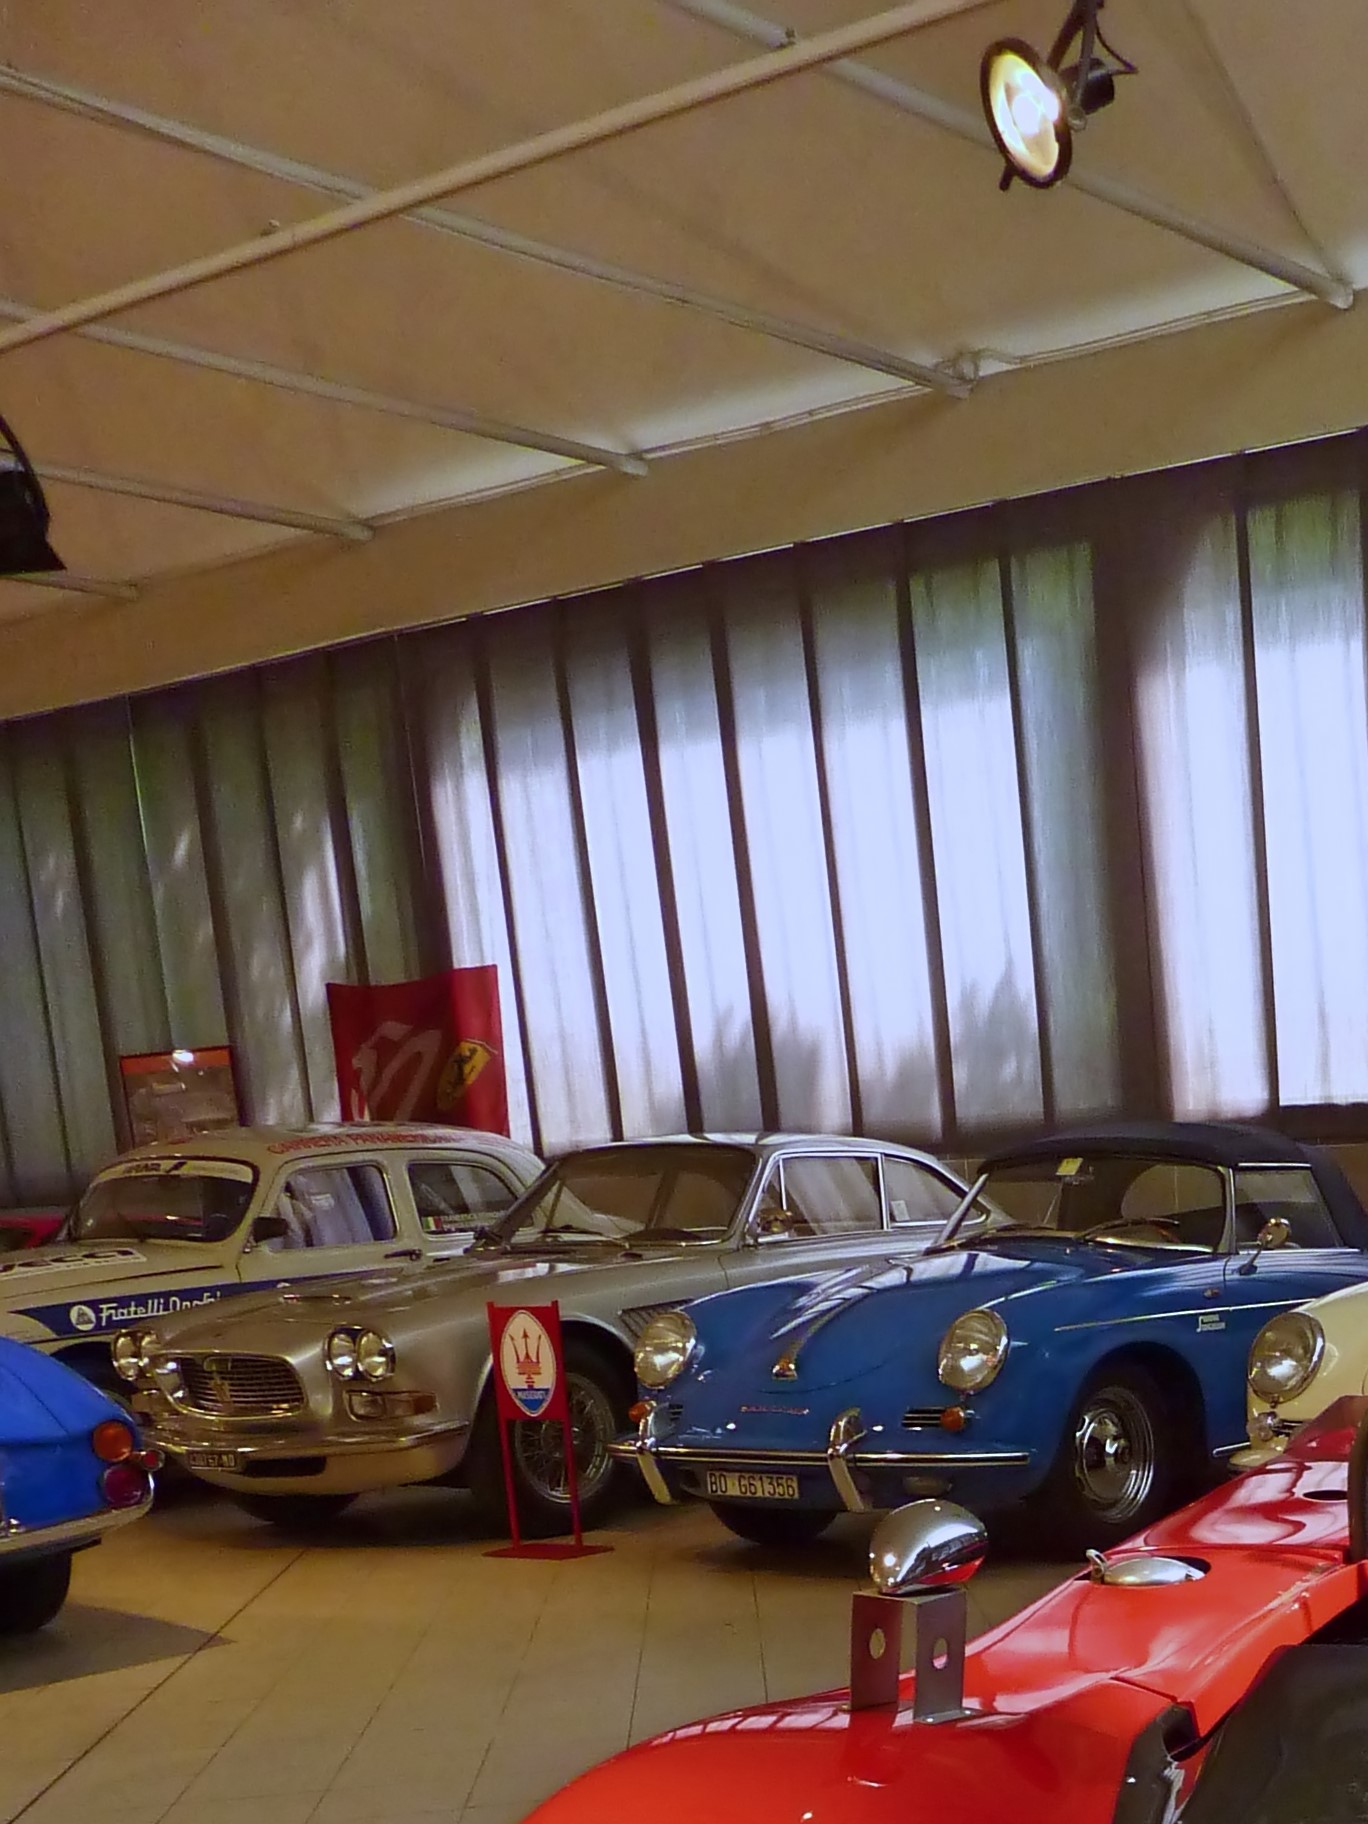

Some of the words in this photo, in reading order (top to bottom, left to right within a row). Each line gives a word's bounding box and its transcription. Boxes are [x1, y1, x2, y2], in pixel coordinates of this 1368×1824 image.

[99, 1298, 165, 1327] Fratelli
[708, 1472, 728, 1494] BO
[737, 1474, 796, 1498] G61356
